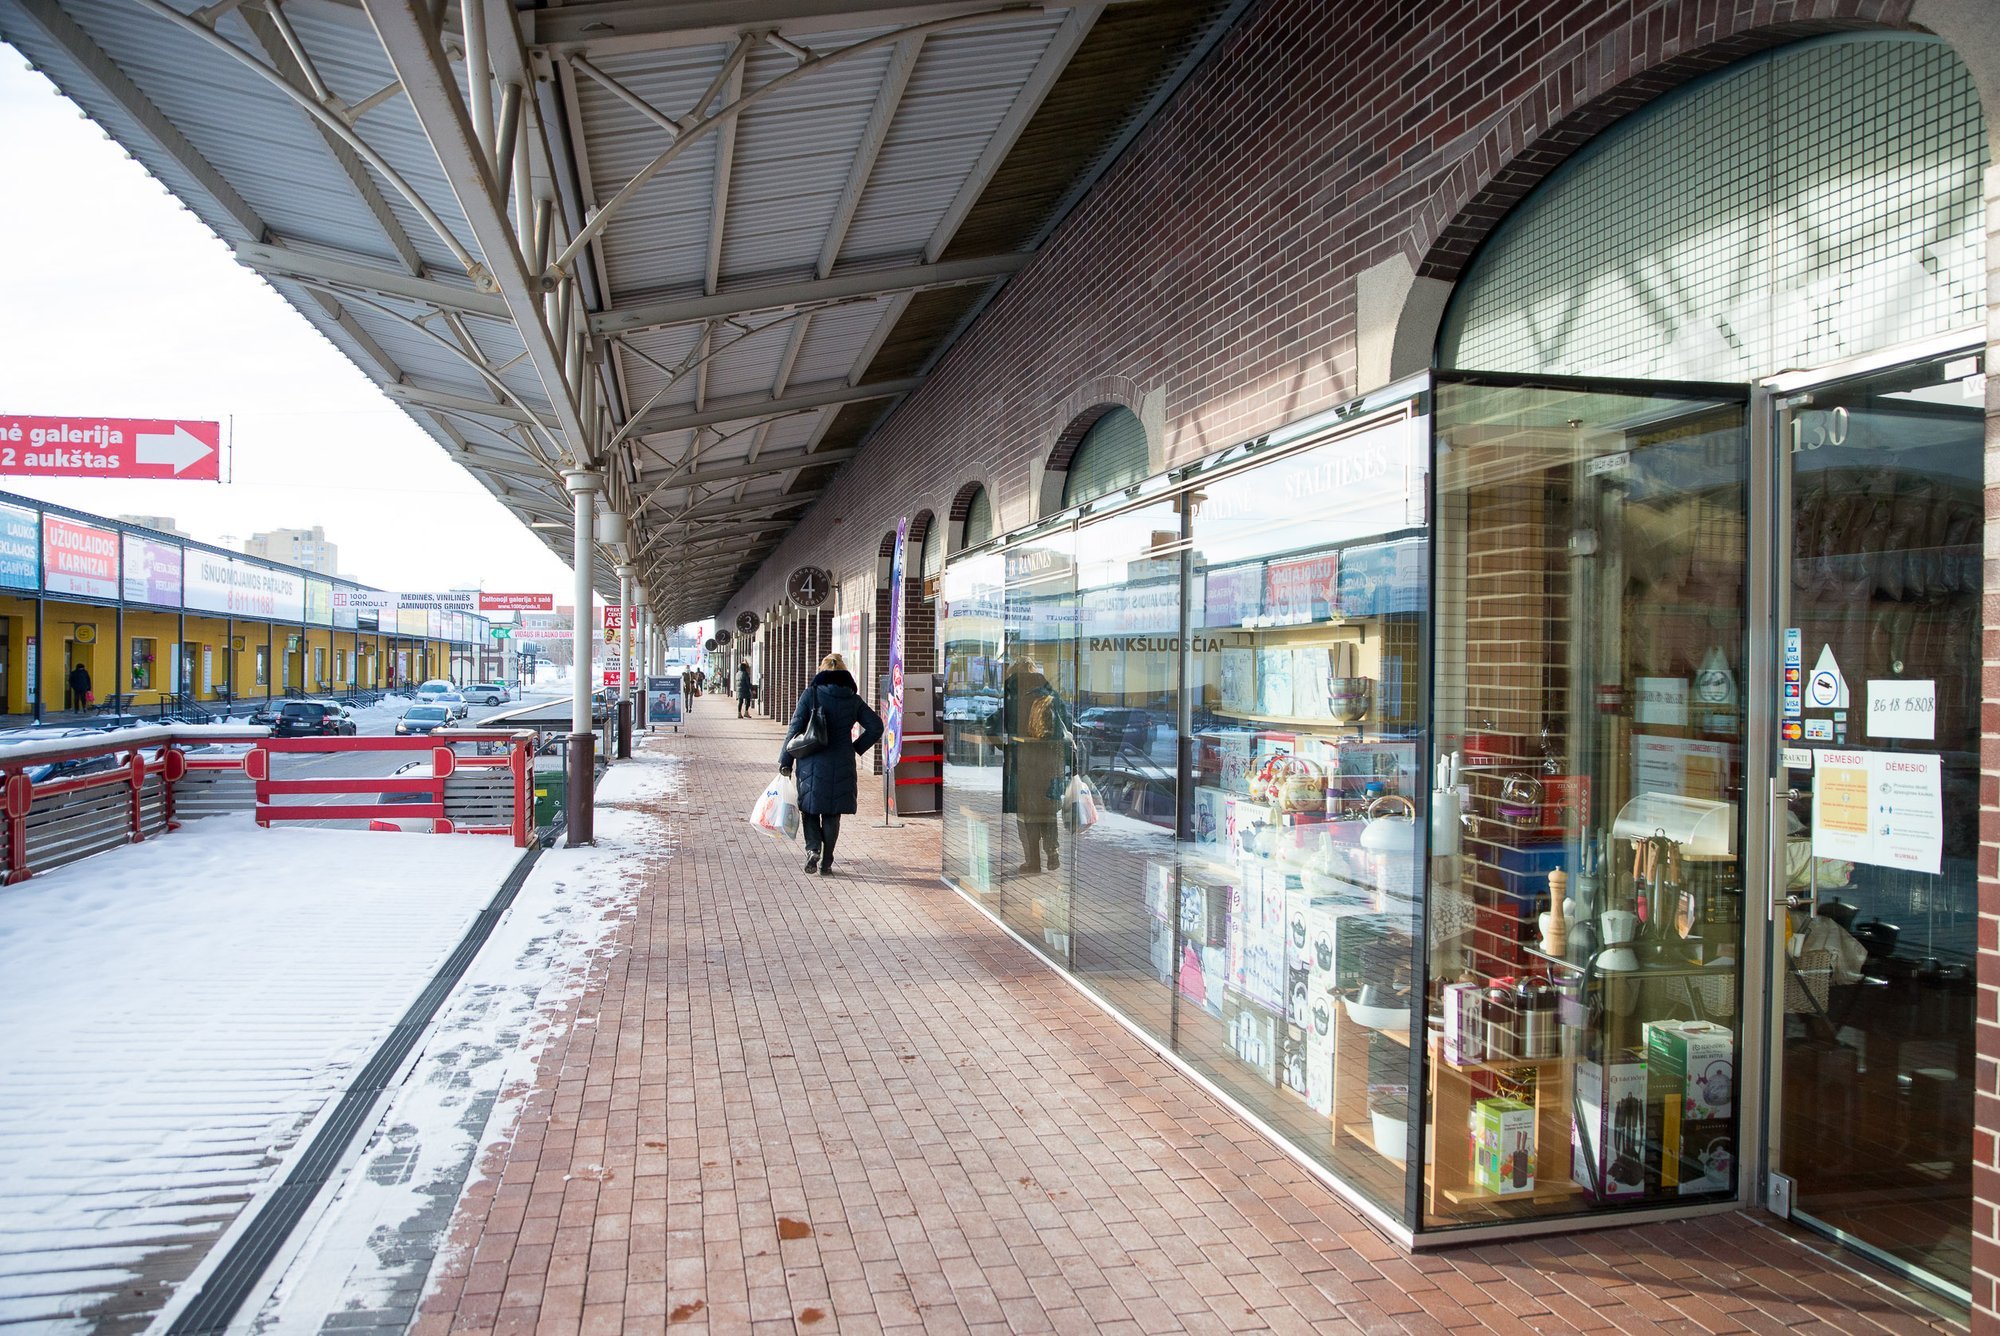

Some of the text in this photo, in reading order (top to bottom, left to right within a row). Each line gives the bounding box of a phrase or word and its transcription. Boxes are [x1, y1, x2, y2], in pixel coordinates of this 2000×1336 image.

[30, 424, 123, 448] galerija
[1790, 406, 1849, 454] 130
[2, 448, 120, 468] 2 aukštas
[1285, 442, 1387, 498] STALTIESĖS
[7, 522, 35, 539] LAUKO
[50, 524, 115, 557] UŽUOLAIDOS
[0, 561, 35, 577] GAMYBA
[58, 552, 108, 577] KARNIZAI
[1009, 560, 1016, 577] IR
[201, 560, 293, 596] IŠNUOMOJAMOS PATALPOS
[800, 574, 815, 599] 4
[401, 592, 470, 602] MEDINĖS, VINILINĖS
[792, 591, 827, 605] GALERIJA
[397, 602, 474, 610] LAMINUOTOS GRINDYS
[744, 615, 752, 630] 3
[515, 630, 534, 638] VIDAUS
[535, 630, 540, 638] IR
[540, 630, 559, 638] LAUKO
[721, 633, 726, 642] 2
[1779, 753, 1808, 762] TRAUKTI
